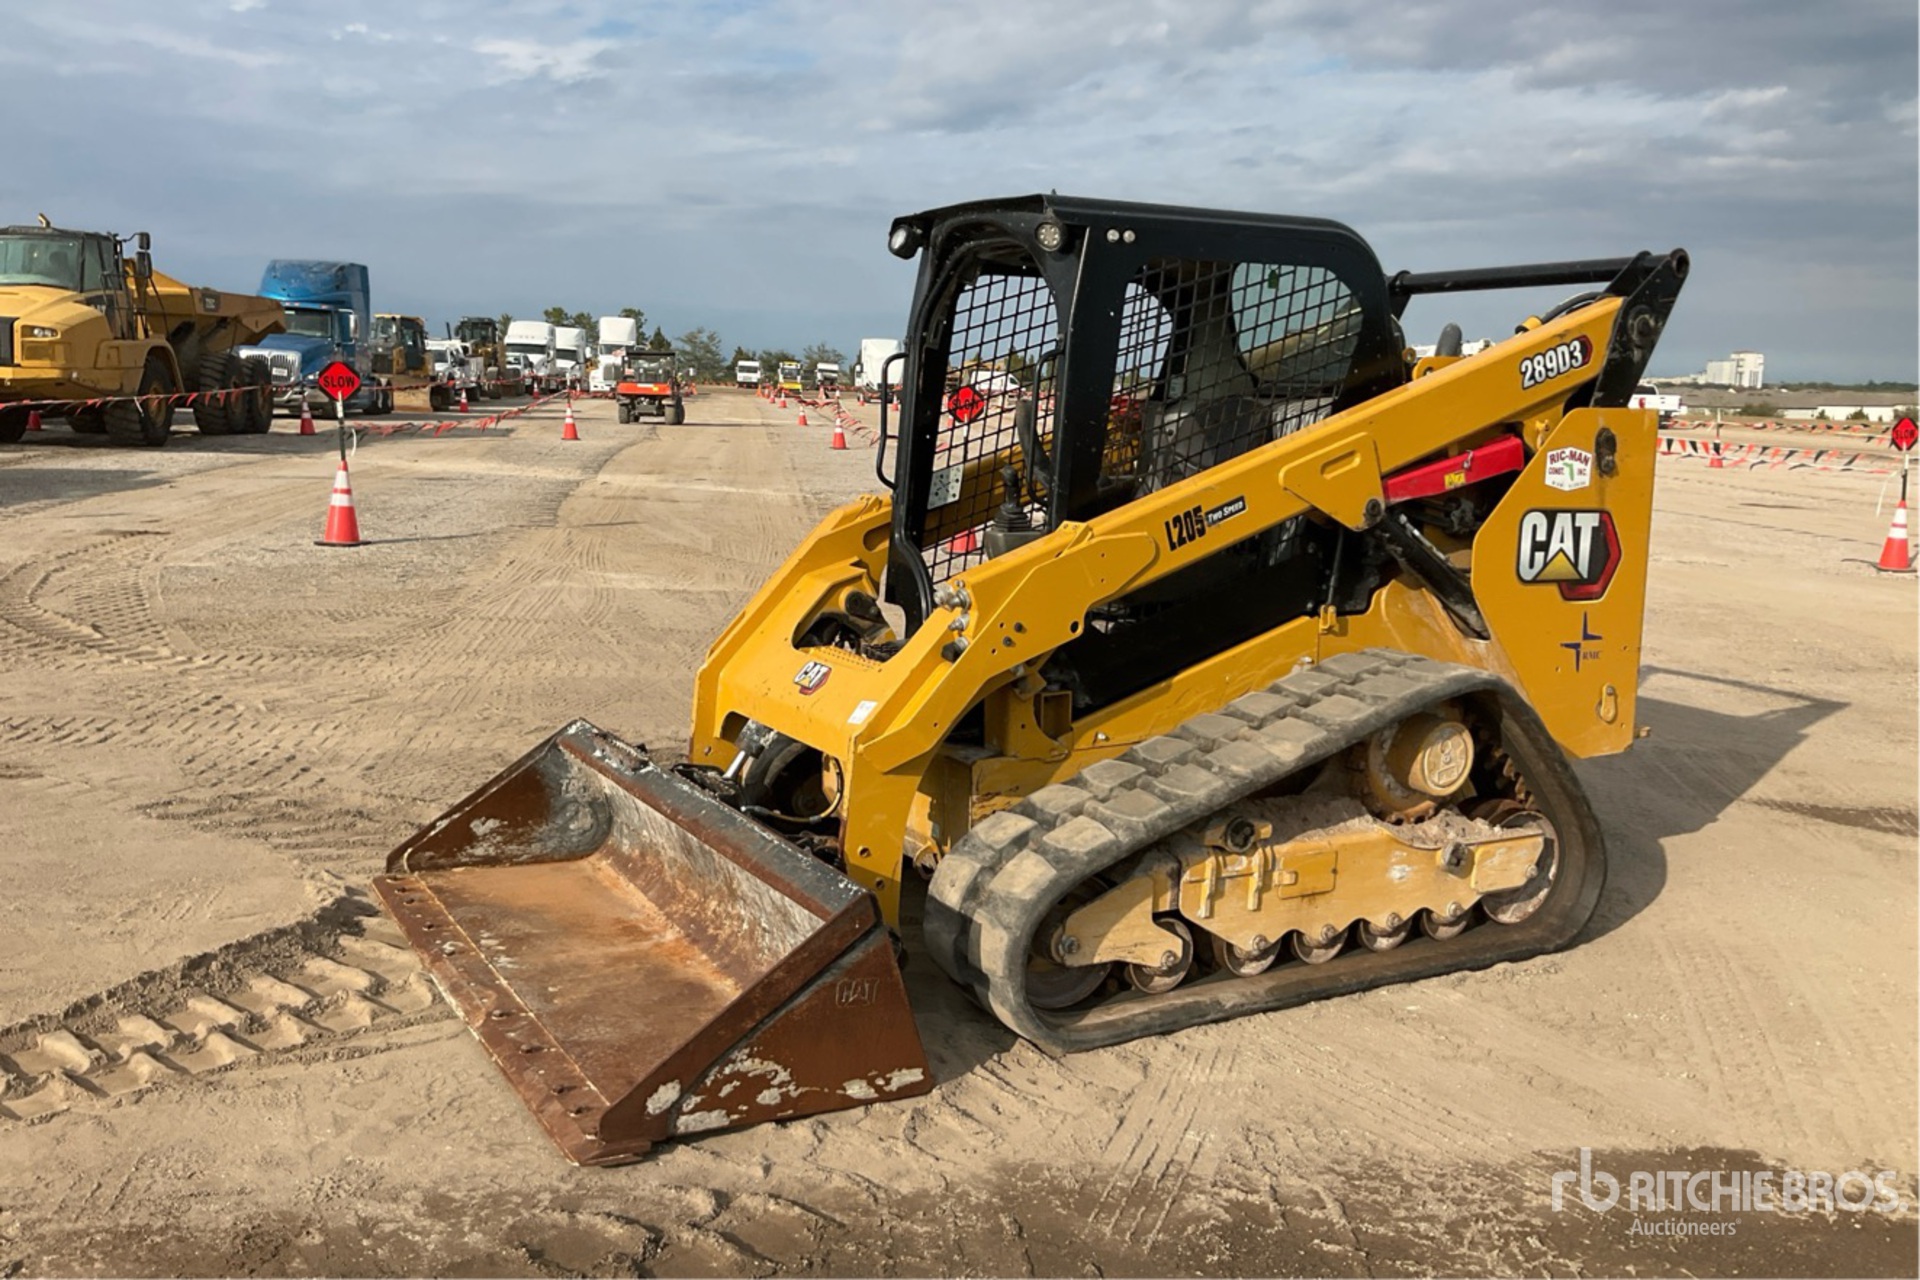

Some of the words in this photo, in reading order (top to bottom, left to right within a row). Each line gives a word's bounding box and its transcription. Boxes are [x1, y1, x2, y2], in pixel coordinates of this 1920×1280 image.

[323, 376, 355, 388] SLOW
[1520, 339, 1583, 389] 289D3
[1549, 450, 1590, 466] RIC-MAN
[1165, 505, 1206, 552] L205
[1518, 511, 1600, 581] CAT
[794, 660, 830, 689] CAT
